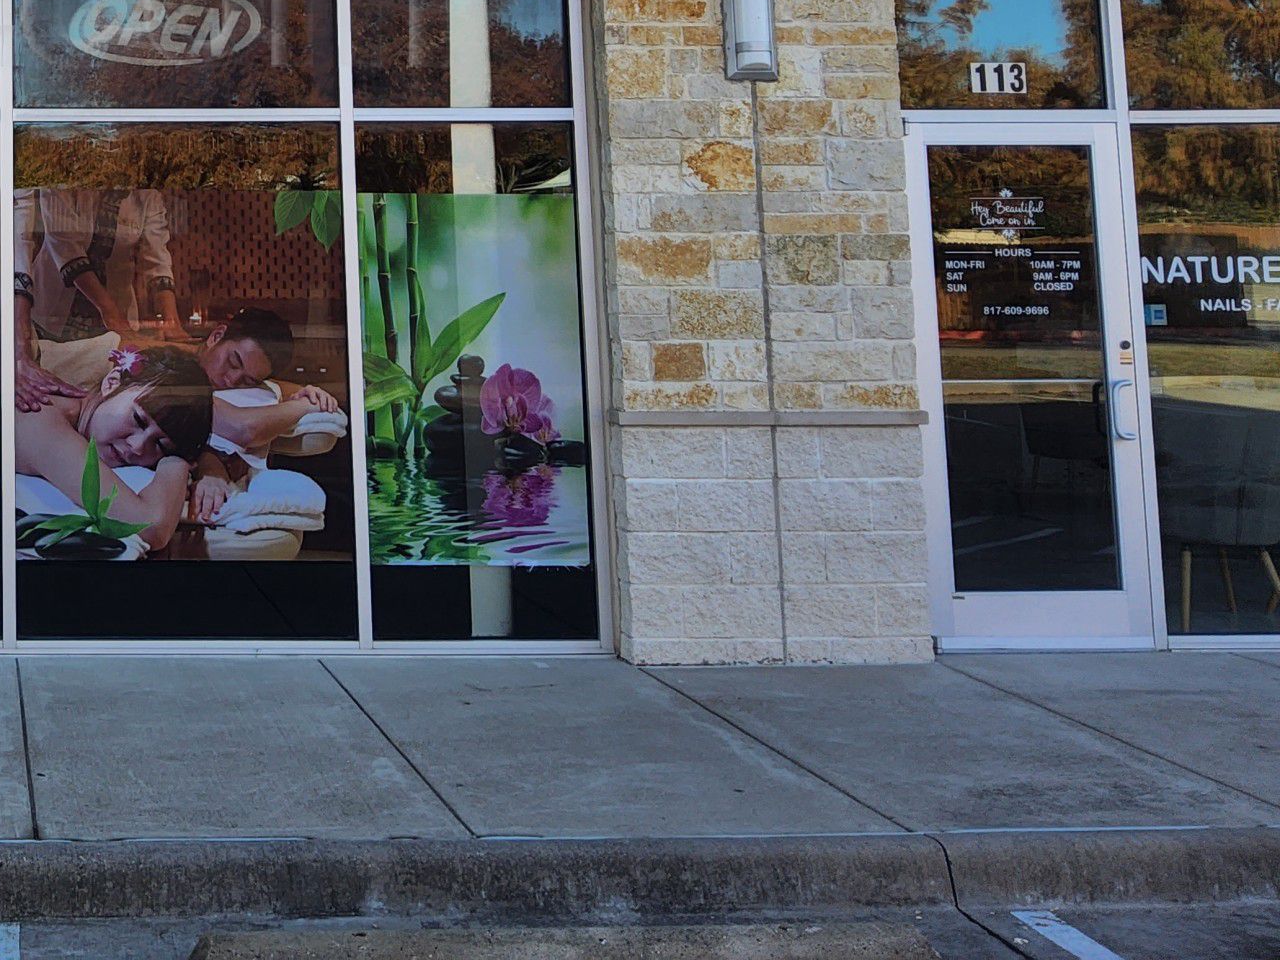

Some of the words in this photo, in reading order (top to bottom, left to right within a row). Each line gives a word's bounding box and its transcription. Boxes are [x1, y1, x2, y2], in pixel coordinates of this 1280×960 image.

[974, 64, 1024, 93] 113
[970, 201, 989, 217] Hey
[992, 200, 1044, 217] Beautiful
[980, 213, 1006, 226] Come
[995, 248, 1032, 257] HOURS
[945, 261, 985, 269] MON-FRI
[1030, 261, 1055, 269] 10AM
[1062, 261, 1081, 269] 7PM
[1141, 256, 1280, 283] NATURE
[946, 272, 964, 280] SAT
[1033, 272, 1053, 280] 9AM
[1060, 272, 1079, 280] 6PM
[947, 284, 967, 292] SUN
[1034, 282, 1073, 291] CLOSED
[1200, 298, 1252, 311] NAILS
[983, 306, 1050, 315] 817-609-9696
